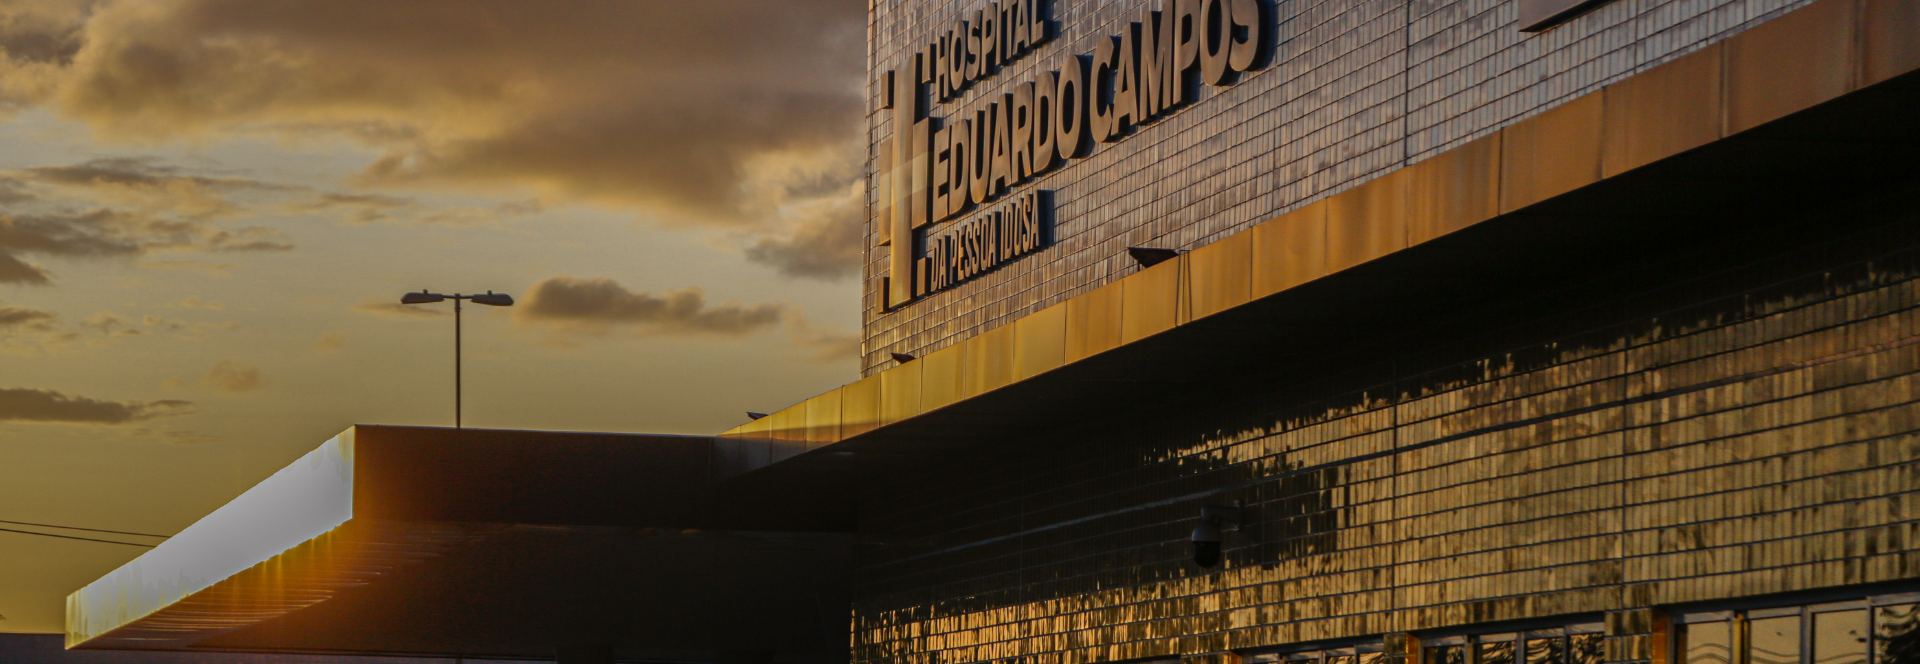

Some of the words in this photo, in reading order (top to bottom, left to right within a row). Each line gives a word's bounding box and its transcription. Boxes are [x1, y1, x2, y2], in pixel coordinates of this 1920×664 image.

[935, 0, 1044, 103] HOSPITAL
[932, 54, 1082, 223] EDUARDO
[1089, 0, 1259, 143] CAMPOS
[930, 235, 947, 292] DA
[949, 210, 996, 285] PESSOA
[1000, 189, 1040, 262] IDOSA
